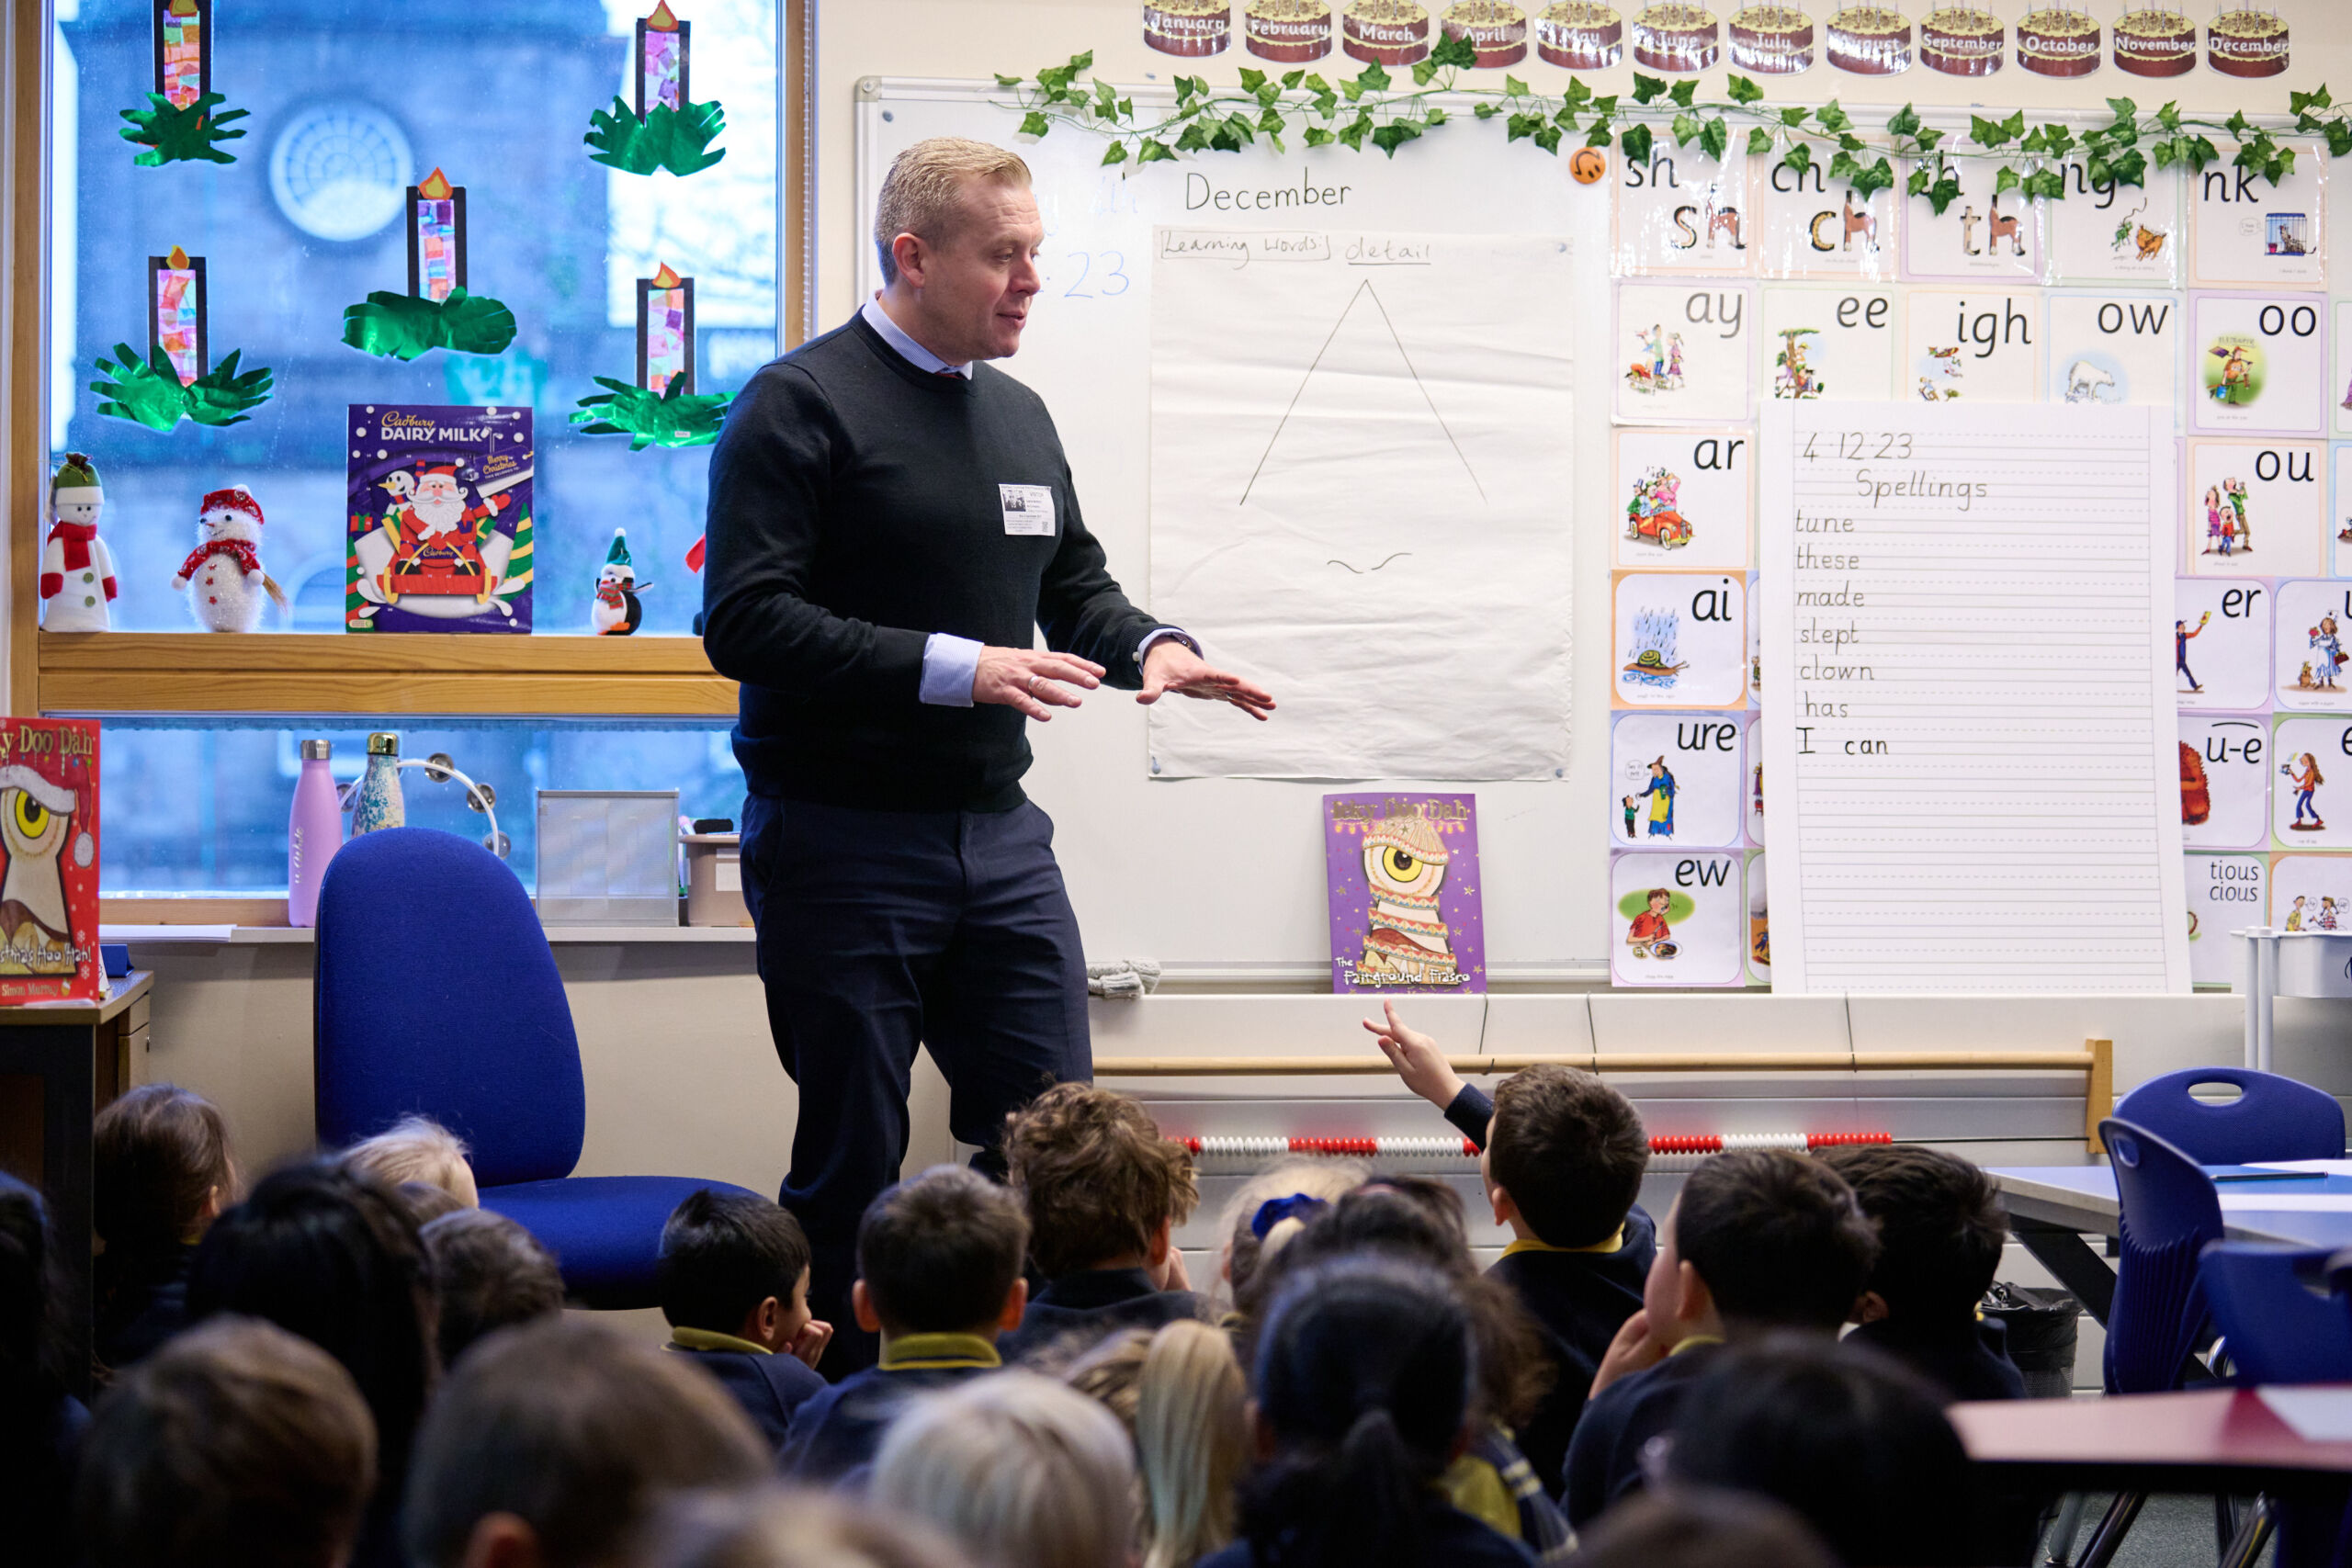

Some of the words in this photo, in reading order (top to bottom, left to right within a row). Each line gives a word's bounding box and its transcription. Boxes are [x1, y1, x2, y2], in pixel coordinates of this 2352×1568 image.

[1152, 12, 1225, 34] January
[1250, 19, 1330, 40] February
[1359, 25, 1415, 41] March
[1463, 27, 1506, 49] April
[1562, 28, 1600, 47] May
[1656, 33, 1698, 47] June
[1756, 33, 1792, 52] July
[1923, 34, 2002, 54] September
[2025, 36, 2094, 52] October
[2115, 36, 2196, 52] November
[2210, 36, 2289, 52] December
[1626, 141, 1679, 187] sh
[1185, 166, 1352, 211] December
[2204, 164, 2259, 203] nk
[1809, 190, 1881, 254] ch
[1960, 194, 2027, 256] th
[1345, 236, 1431, 262] detail
[1685, 291, 1743, 339] ay
[1837, 297, 1889, 328] ee
[2098, 303, 2169, 335] ow
[2259, 305, 2316, 337] oo
[1958, 299, 2031, 358] igh
[381, 411, 435, 429] Cadbury
[381, 427, 435, 441] DAIRY
[438, 427, 482, 442] MILK
[1693, 438, 1745, 470] ar
[2256, 450, 2314, 482] ou
[1856, 468, 1988, 512] Spellings
[1795, 509, 1855, 534] tune
[1796, 544, 1860, 570] these
[1691, 578, 1733, 622] ai
[1796, 580, 1865, 607] made
[2221, 588, 2261, 619] er
[1799, 616, 1860, 656] slept
[1799, 654, 1875, 681] clown
[1804, 691, 1849, 717] has
[59, 727, 93, 755] Dah
[1677, 722, 1736, 751] ure
[1795, 727, 1816, 754] I
[1844, 737, 1889, 756] can
[1675, 859, 1731, 887] ew
[2211, 860, 2258, 881] tious
[2210, 882, 2257, 902] cious
[1335, 956, 1353, 967] The
[1343, 969, 1422, 988] Fairground
[1430, 969, 1471, 984] Fiasco
